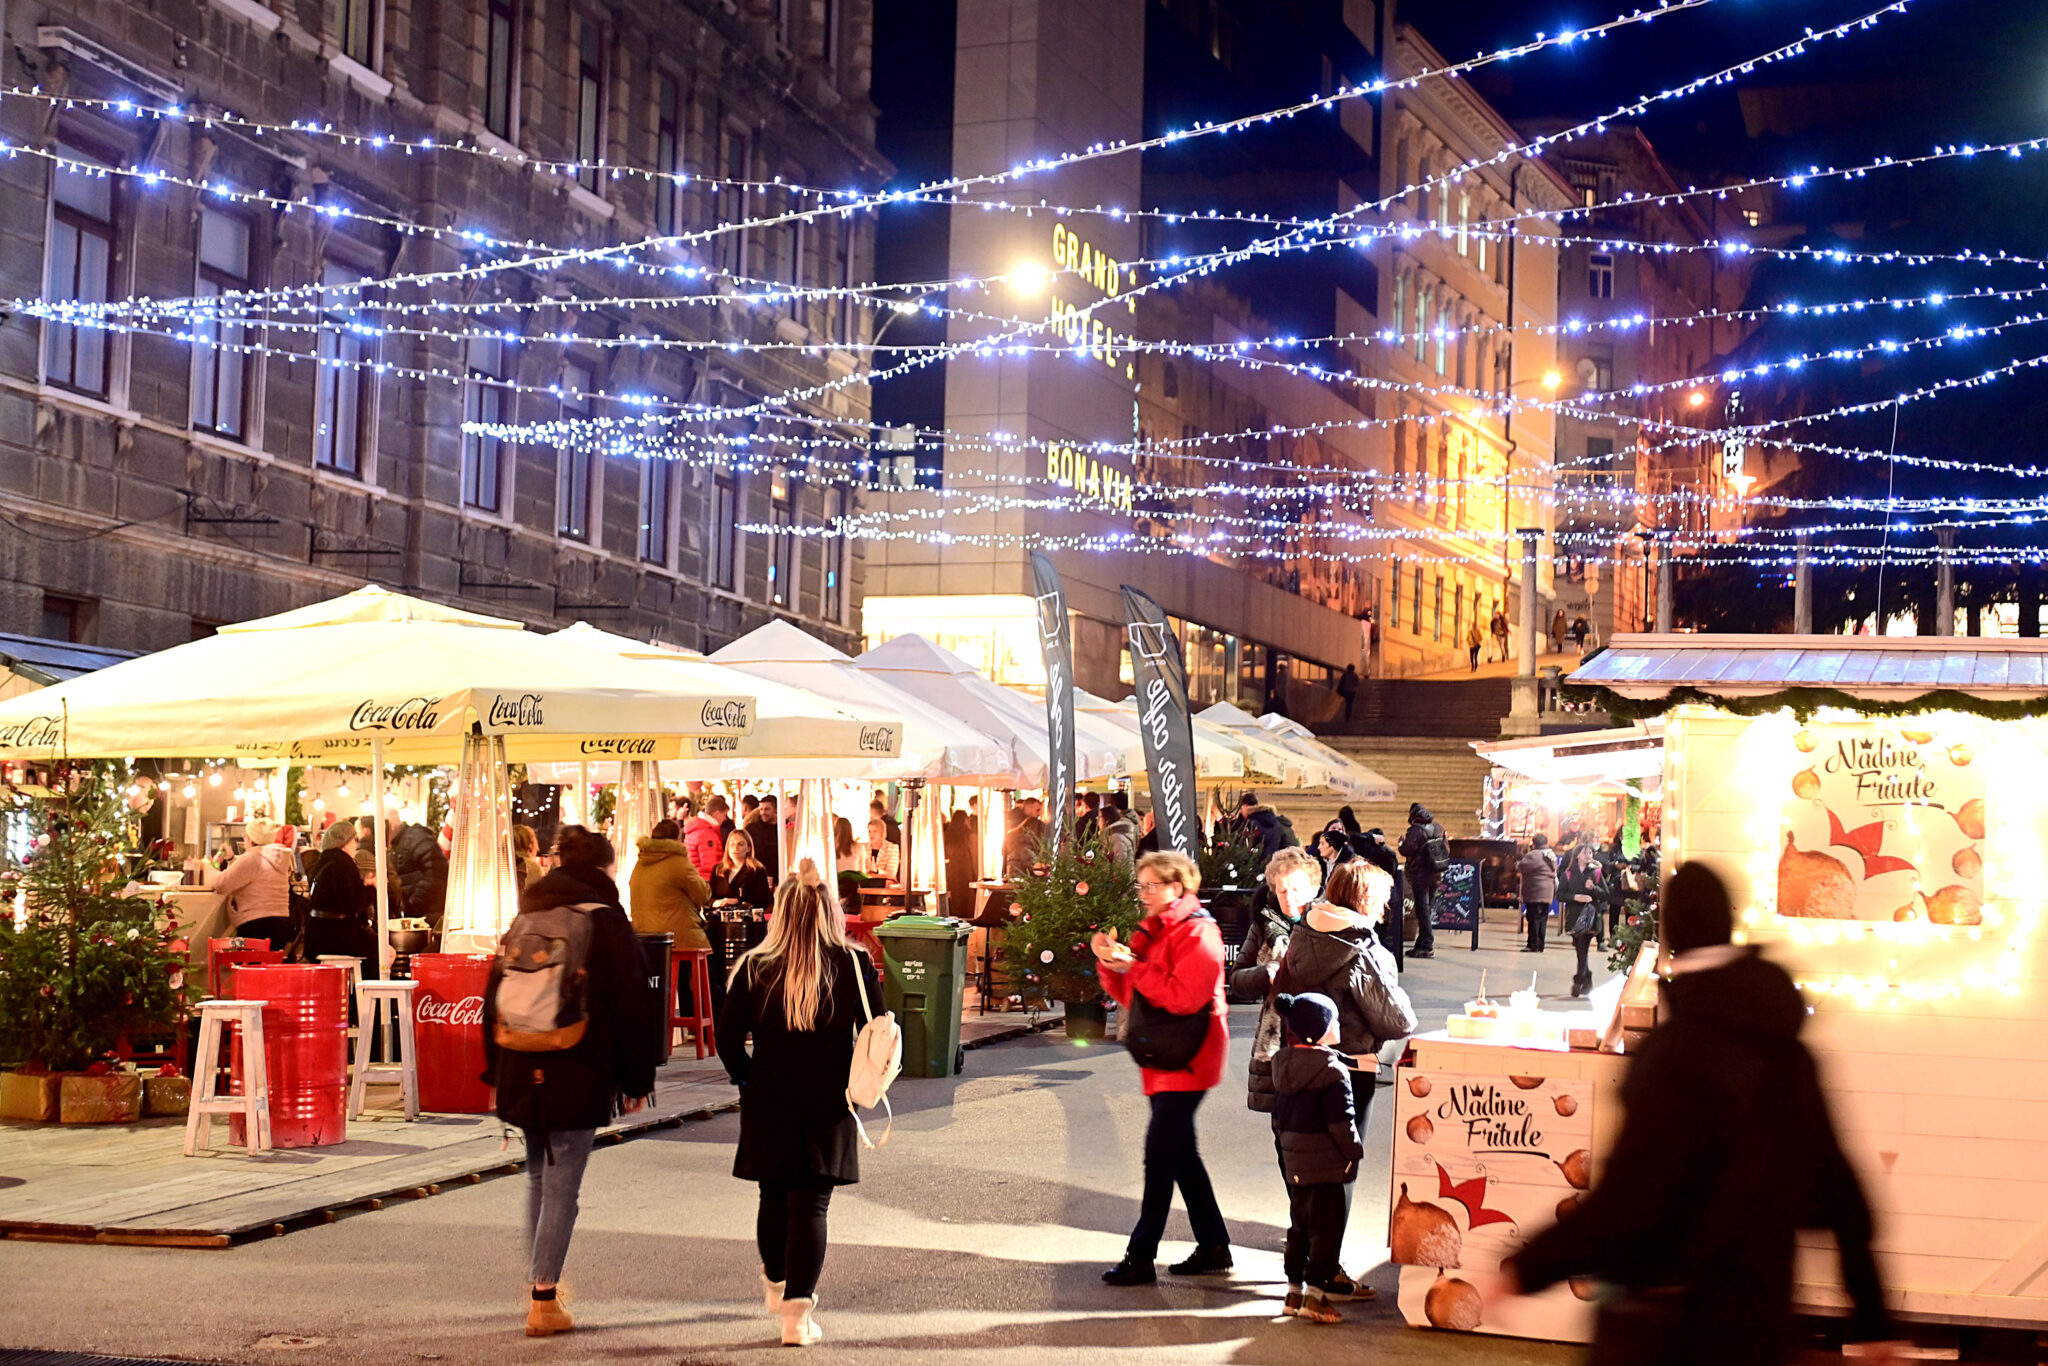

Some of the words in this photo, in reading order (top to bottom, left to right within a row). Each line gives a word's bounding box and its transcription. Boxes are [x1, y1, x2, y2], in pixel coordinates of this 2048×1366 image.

[1053, 223, 1119, 297] GRAND
[1051, 296, 1116, 367] HOTEL
[1047, 441, 1132, 511] BONAVIA
[350, 697, 443, 731] Coca-Cola
[488, 694, 543, 727] Coca-Cola
[701, 699, 746, 729] Coca-Cola
[859, 725, 893, 752] Coca-Cola
[1825, 738, 1918, 773] Nadine
[1437, 1085, 1528, 1119] Nadine
[1462, 1113, 1544, 1148] Fritule
